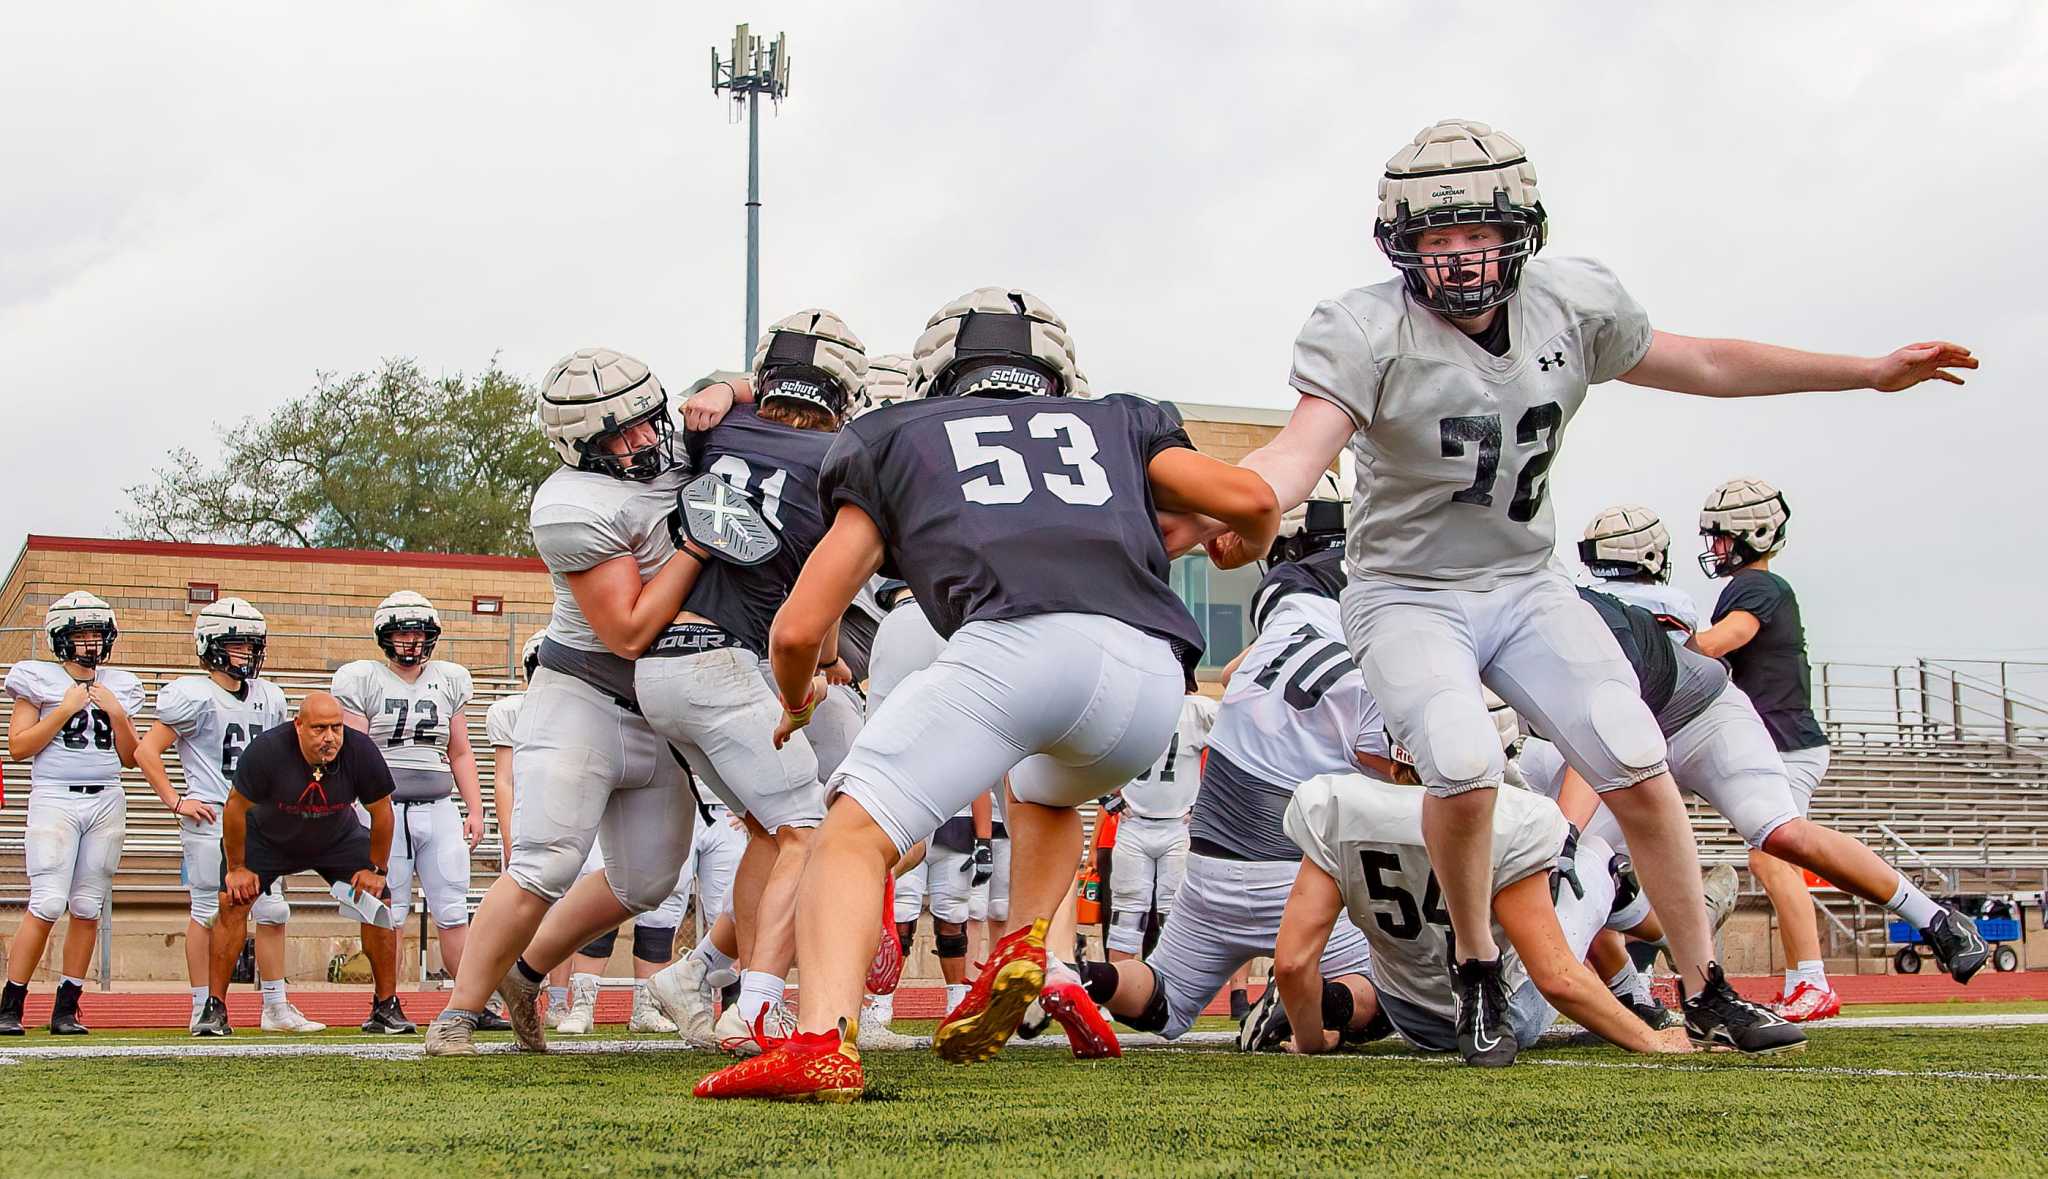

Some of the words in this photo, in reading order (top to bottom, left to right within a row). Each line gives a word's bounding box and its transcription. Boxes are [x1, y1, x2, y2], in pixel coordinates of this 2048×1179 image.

[780, 380, 819, 396] schutt
[990, 368, 1041, 388] schutt
[944, 412, 1113, 506] 53
[1440, 401, 1562, 522] 72
[384, 699, 439, 748] 72
[221, 723, 263, 781] 6
